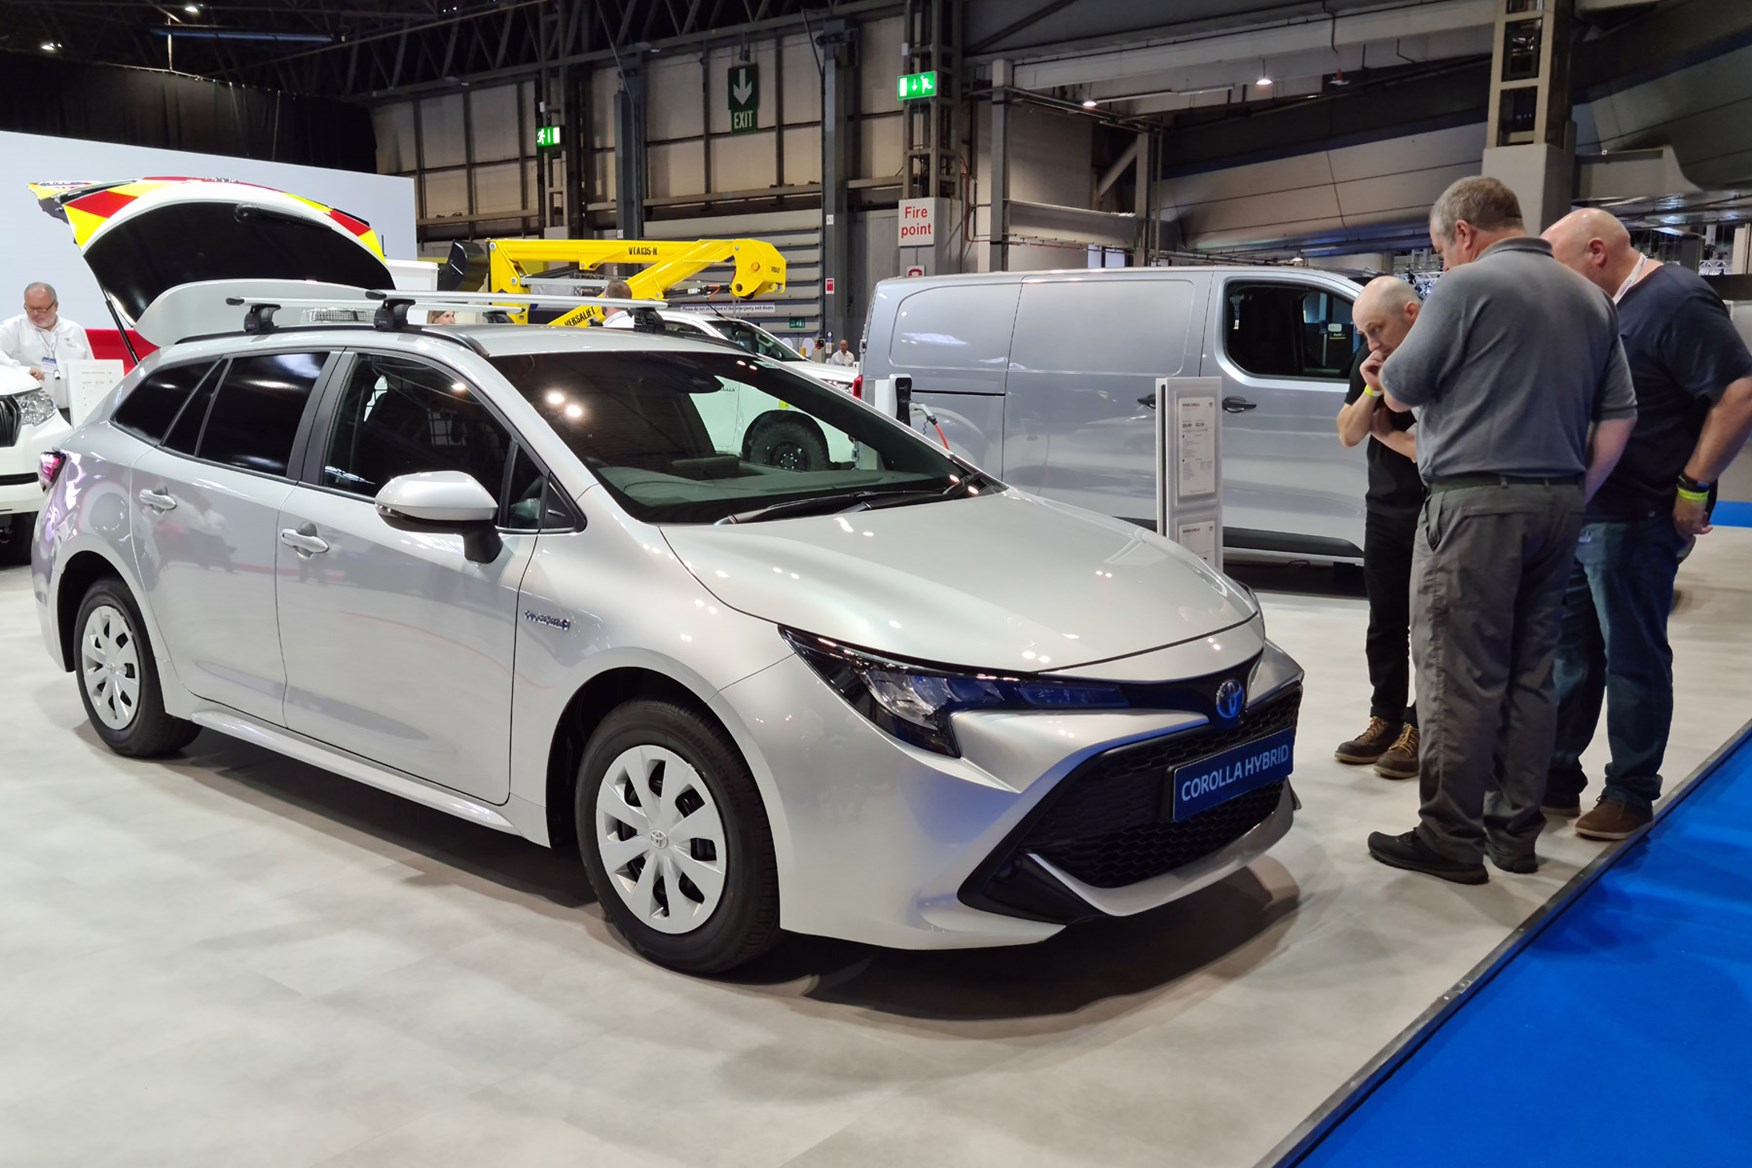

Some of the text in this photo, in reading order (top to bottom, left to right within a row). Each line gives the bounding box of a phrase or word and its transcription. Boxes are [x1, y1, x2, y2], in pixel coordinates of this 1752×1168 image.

[734, 110, 753, 129] EXIT
[904, 206, 928, 219] Fire
[901, 223, 932, 239] point
[564, 306, 596, 326] VERSALIFT
[1181, 744, 1289, 801] COROLLA HYBRID
